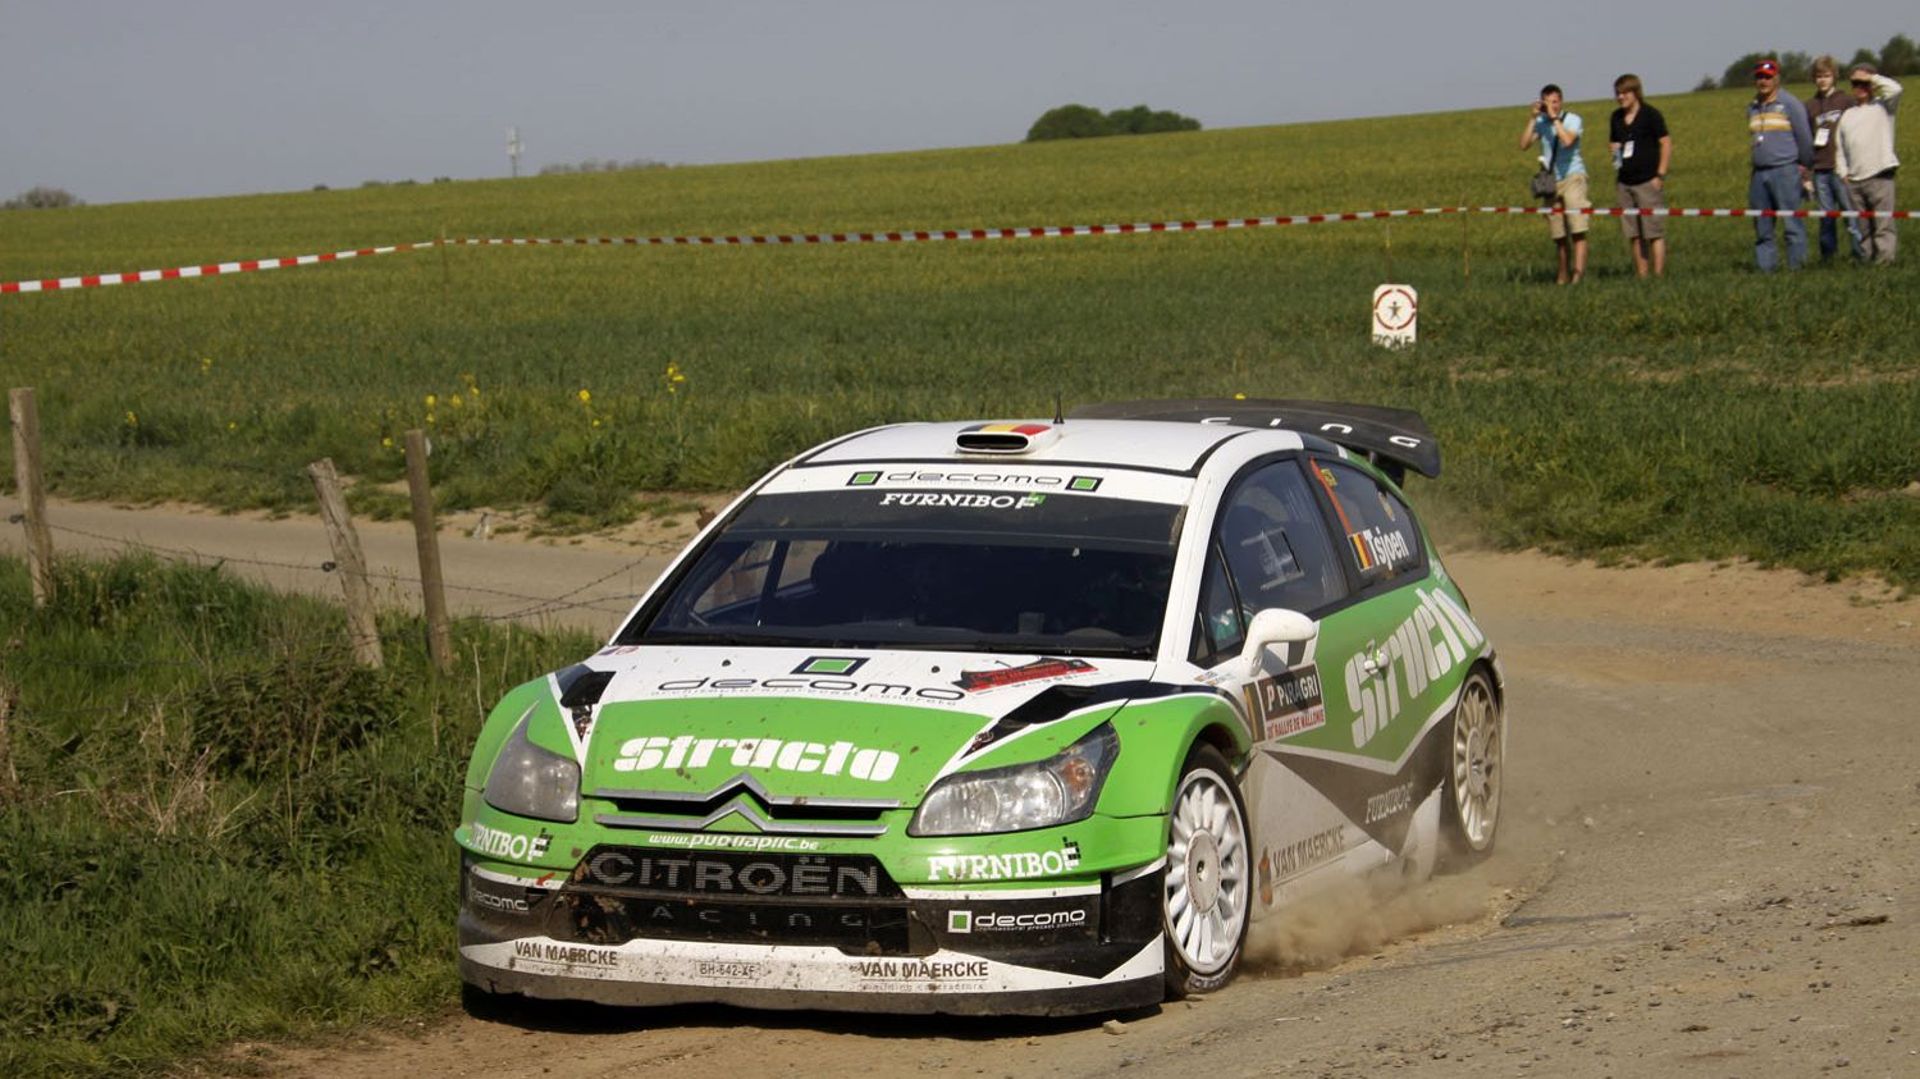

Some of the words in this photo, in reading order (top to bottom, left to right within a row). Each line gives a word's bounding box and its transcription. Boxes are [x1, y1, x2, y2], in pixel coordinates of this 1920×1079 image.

[887, 471, 1062, 485] decomo
[658, 677, 965, 700] decomo
[590, 851, 878, 895] CITROËN
[975, 909, 1086, 927] decomo
[515, 941, 542, 959] VAN
[546, 945, 619, 966] MAERCKE
[860, 961, 897, 977] VAN
[902, 961, 989, 978] MAERCKE
